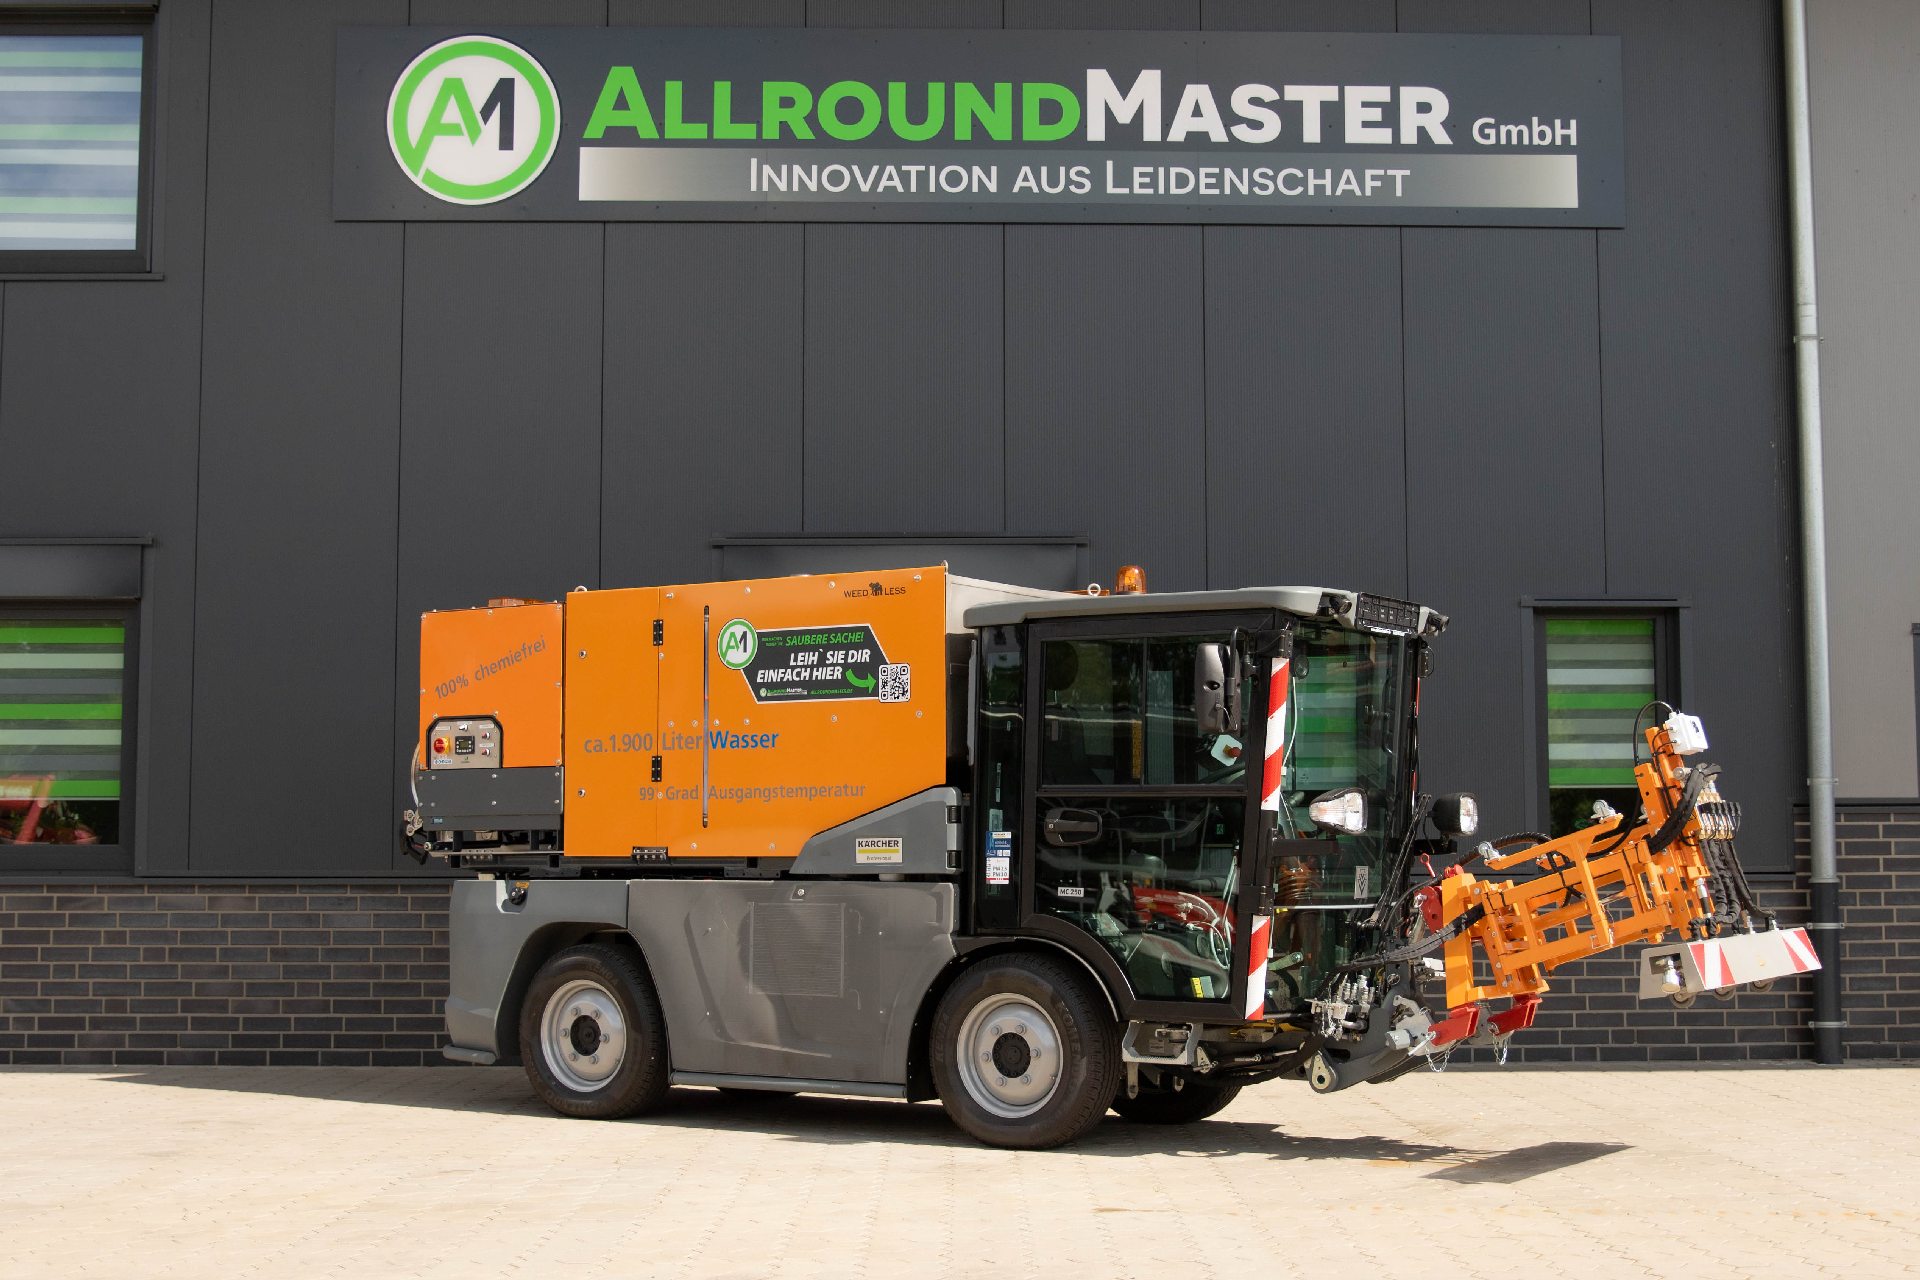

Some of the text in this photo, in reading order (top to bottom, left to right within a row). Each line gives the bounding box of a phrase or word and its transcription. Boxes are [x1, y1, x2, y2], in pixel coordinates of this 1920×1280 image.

[583, 66, 1578, 146] ALLROUNDMASTER GmbH
[751, 157, 1411, 197] INNOVATION AUS LEIDENSCHAFT
[843, 586, 907, 598] WEED LESS
[785, 633, 828, 647] SAUBERE
[829, 631, 865, 644] SACHE!
[825, 650, 846, 664] SIE
[847, 648, 871, 664] DIR
[435, 634, 547, 699] 100% chemiefrei
[756, 665, 843, 683] EINFACH HIER
[661, 731, 703, 750] Liter
[708, 730, 779, 750] Wasser
[665, 784, 699, 801] Grad
[708, 783, 866, 803] Ausgangstemperatur
[857, 839, 900, 848] KÄRCHER
